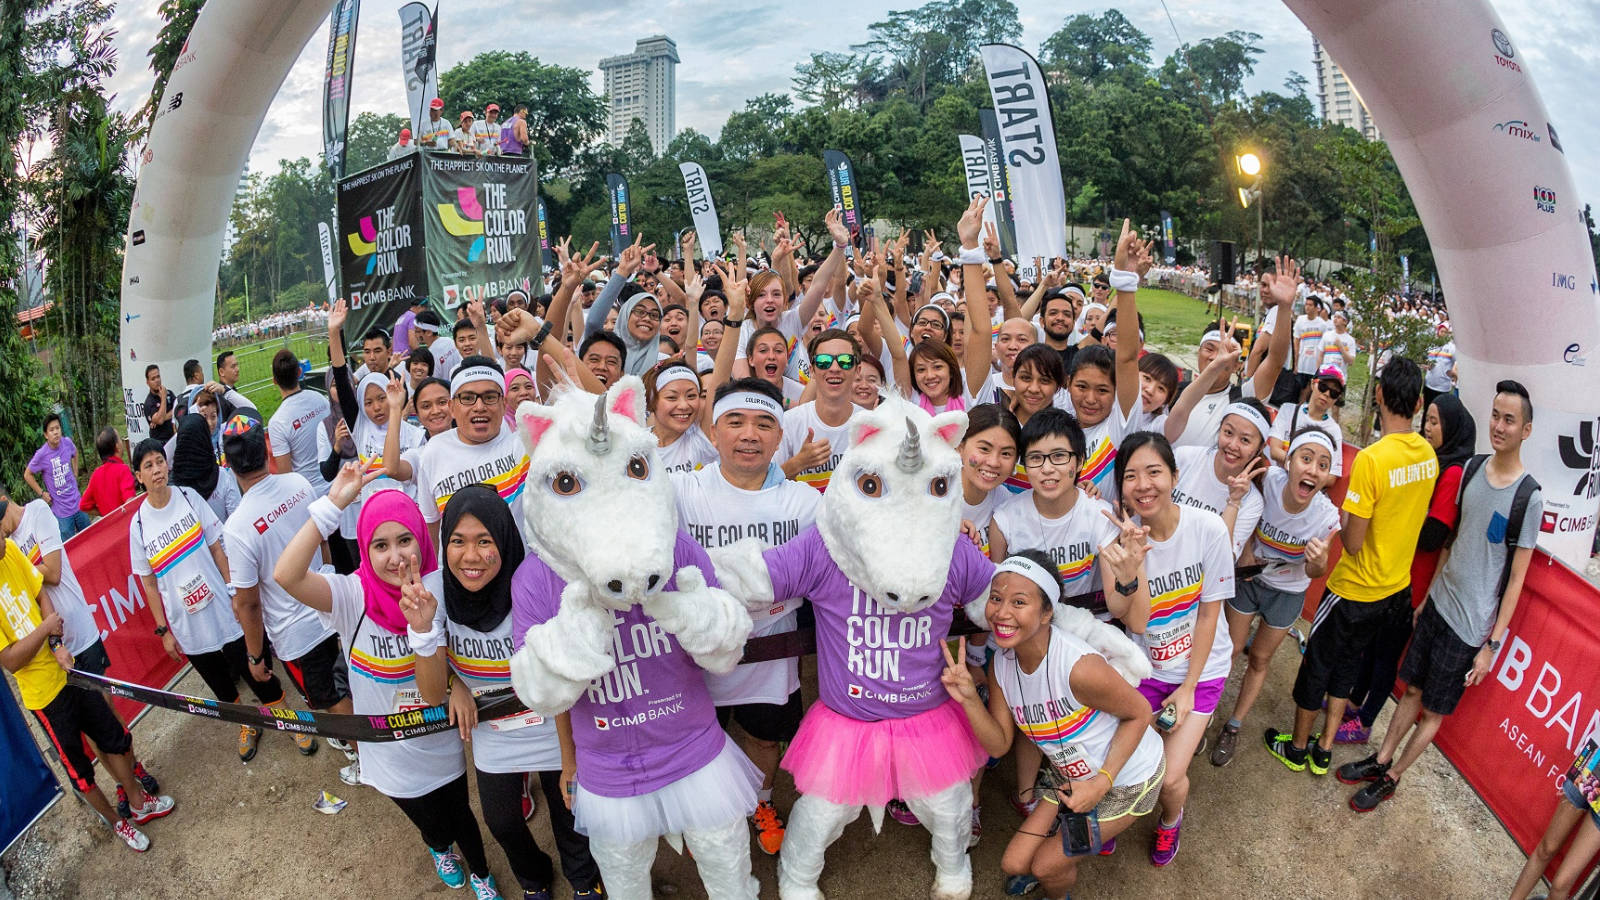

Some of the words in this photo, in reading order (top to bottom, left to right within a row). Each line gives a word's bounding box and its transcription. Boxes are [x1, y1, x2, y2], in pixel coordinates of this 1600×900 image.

[1494, 54, 1522, 73] TOYOTA
[430, 160, 444, 171] THE
[444, 160, 475, 172] HAPPIEST
[475, 162, 484, 172] 5K
[484, 162, 494, 172] ON
[494, 163, 505, 173] THE
[483, 183, 508, 209] THE
[1536, 202, 1555, 213] PLUS
[376, 205, 396, 230] THE
[484, 209, 527, 236] COLOR
[376, 224, 412, 254] COLOR
[486, 236, 517, 265] RUN.
[376, 252, 403, 277] RUN.
[1551, 272, 1576, 290] IMG
[361, 291, 387, 306] CIMB
[387, 285, 416, 303] BANK
[437, 476, 455, 497] THE
[458, 462, 496, 489] COLOR
[495, 453, 517, 475] RUN
[266, 501, 288, 524] CIMB
[287, 488, 308, 510] BANK
[157, 522, 184, 549] COLOR
[180, 511, 198, 535] RUN
[689, 523, 714, 548] THE
[772, 518, 799, 547] RUN
[1263, 522, 1290, 543] COLOR
[1559, 516, 1587, 533] CIMB
[184, 584, 209, 606] 01745
[1147, 571, 1184, 599] COLOR
[613, 621, 672, 664] LOR
[846, 615, 932, 649] COLOR
[1162, 627, 1180, 640] COLOR
[370, 634, 397, 659] THE
[463, 637, 504, 660] COLOR
[1151, 636, 1191, 660] 07868
[847, 646, 906, 682] RUN.
[586, 662, 644, 705] RUN
[899, 687, 932, 702] BANK
[270, 707, 299, 721] COLOR
[368, 716, 388, 730] THE
[387, 710, 423, 728] COLOR
[422, 706, 446, 722] RUN
[611, 713, 647, 728] CIMB
[647, 701, 685, 721] BANK
[1016, 703, 1047, 726] COLOR
[1046, 696, 1075, 722] RUN
[284, 723, 300, 732] CIMB
[404, 726, 427, 737] CIMB
[426, 721, 450, 734] BANK
[1499, 717, 1546, 768] ASEAN
